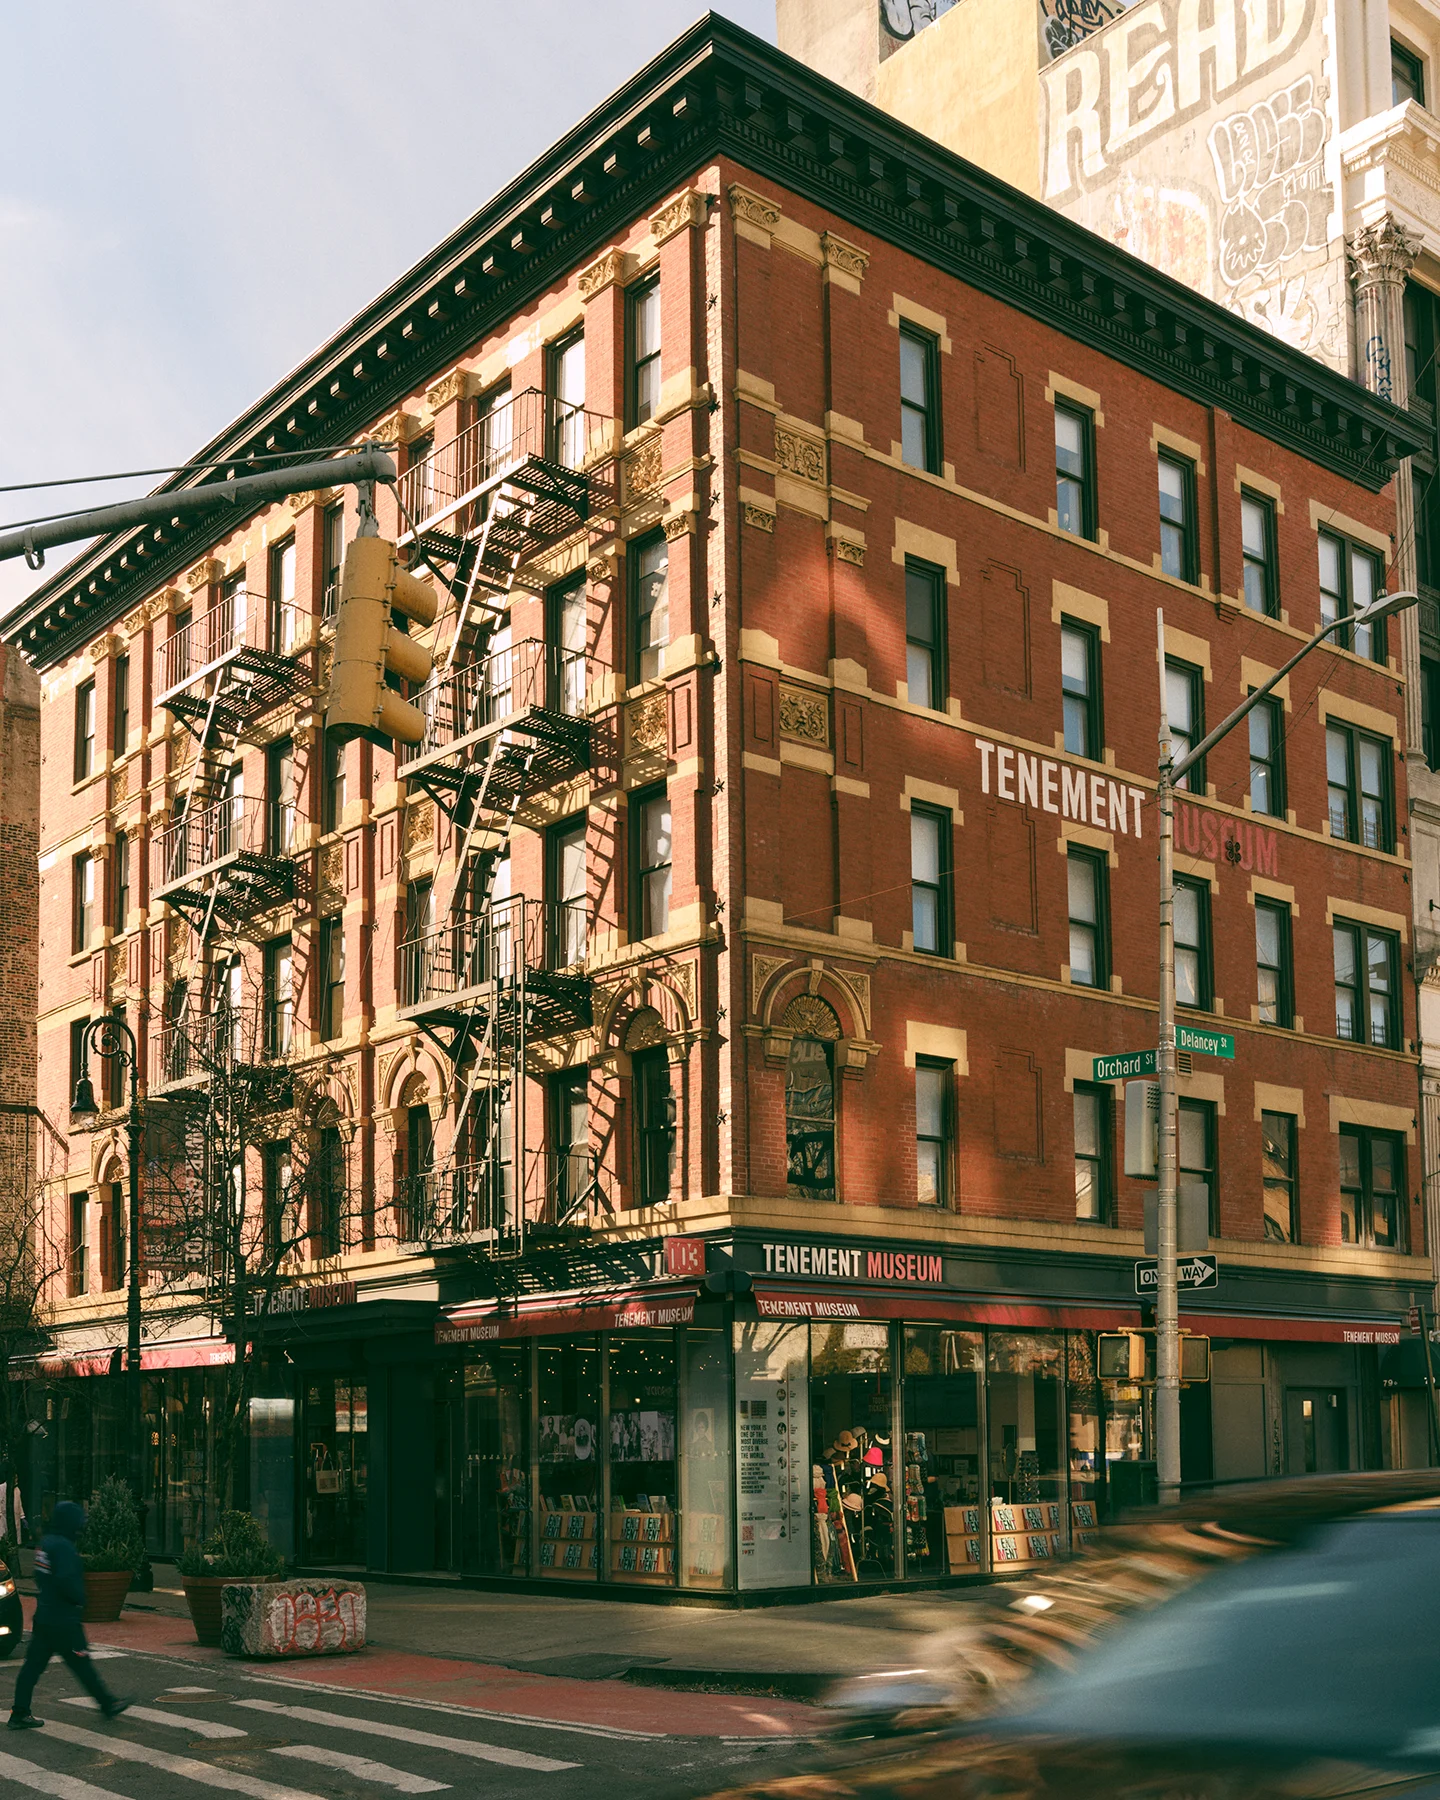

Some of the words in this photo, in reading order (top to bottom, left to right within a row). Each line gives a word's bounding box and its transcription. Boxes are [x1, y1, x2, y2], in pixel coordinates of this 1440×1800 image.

[1044, 0, 1312, 202] READ
[975, 738, 1146, 839] TENEMENT
[1181, 1030, 1218, 1055] Delancey
[1221, 1037, 1227, 1048] St
[1097, 1056, 1141, 1078] Orchard
[1145, 1053, 1153, 1065] St
[763, 1244, 861, 1277] TENEMENT
[867, 1251, 942, 1282] MUSEUM
[1143, 1271, 1158, 1283] ON
[1182, 1266, 1207, 1280] WAY
[309, 1281, 356, 1309] MUSEUM
[615, 1310, 655, 1327] TENEMENT
[658, 1306, 694, 1324] MUSEUM
[758, 1300, 812, 1316] TENEMENT
[815, 1302, 861, 1317] MUSEUM
[436, 1329, 469, 1343] TENEMENT
[470, 1325, 500, 1340] MUSEUM
[1343, 1331, 1373, 1343] TENEMENT
[1375, 1332, 1400, 1343] MUSEUM
[1383, 1379, 1393, 1387] 79
